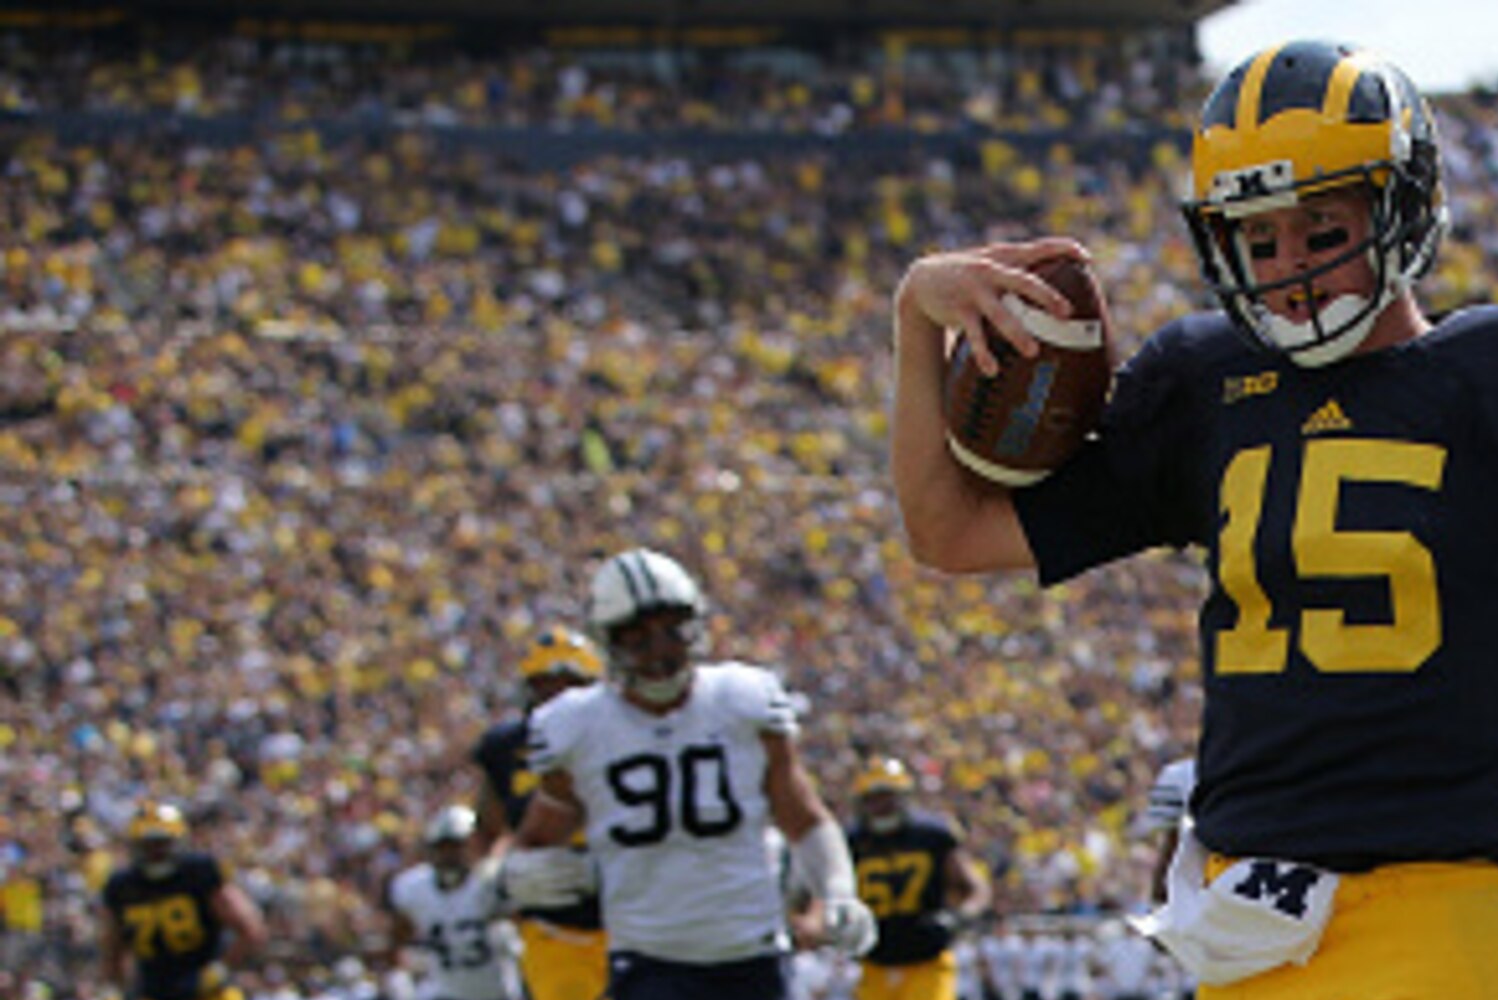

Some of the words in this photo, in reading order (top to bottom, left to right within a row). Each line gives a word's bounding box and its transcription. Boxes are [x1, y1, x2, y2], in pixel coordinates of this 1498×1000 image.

[1214, 438, 1448, 675] 15
[607, 744, 742, 847] 90
[856, 851, 933, 919] 67
[1234, 862, 1321, 920] M
[122, 893, 205, 957] 78
